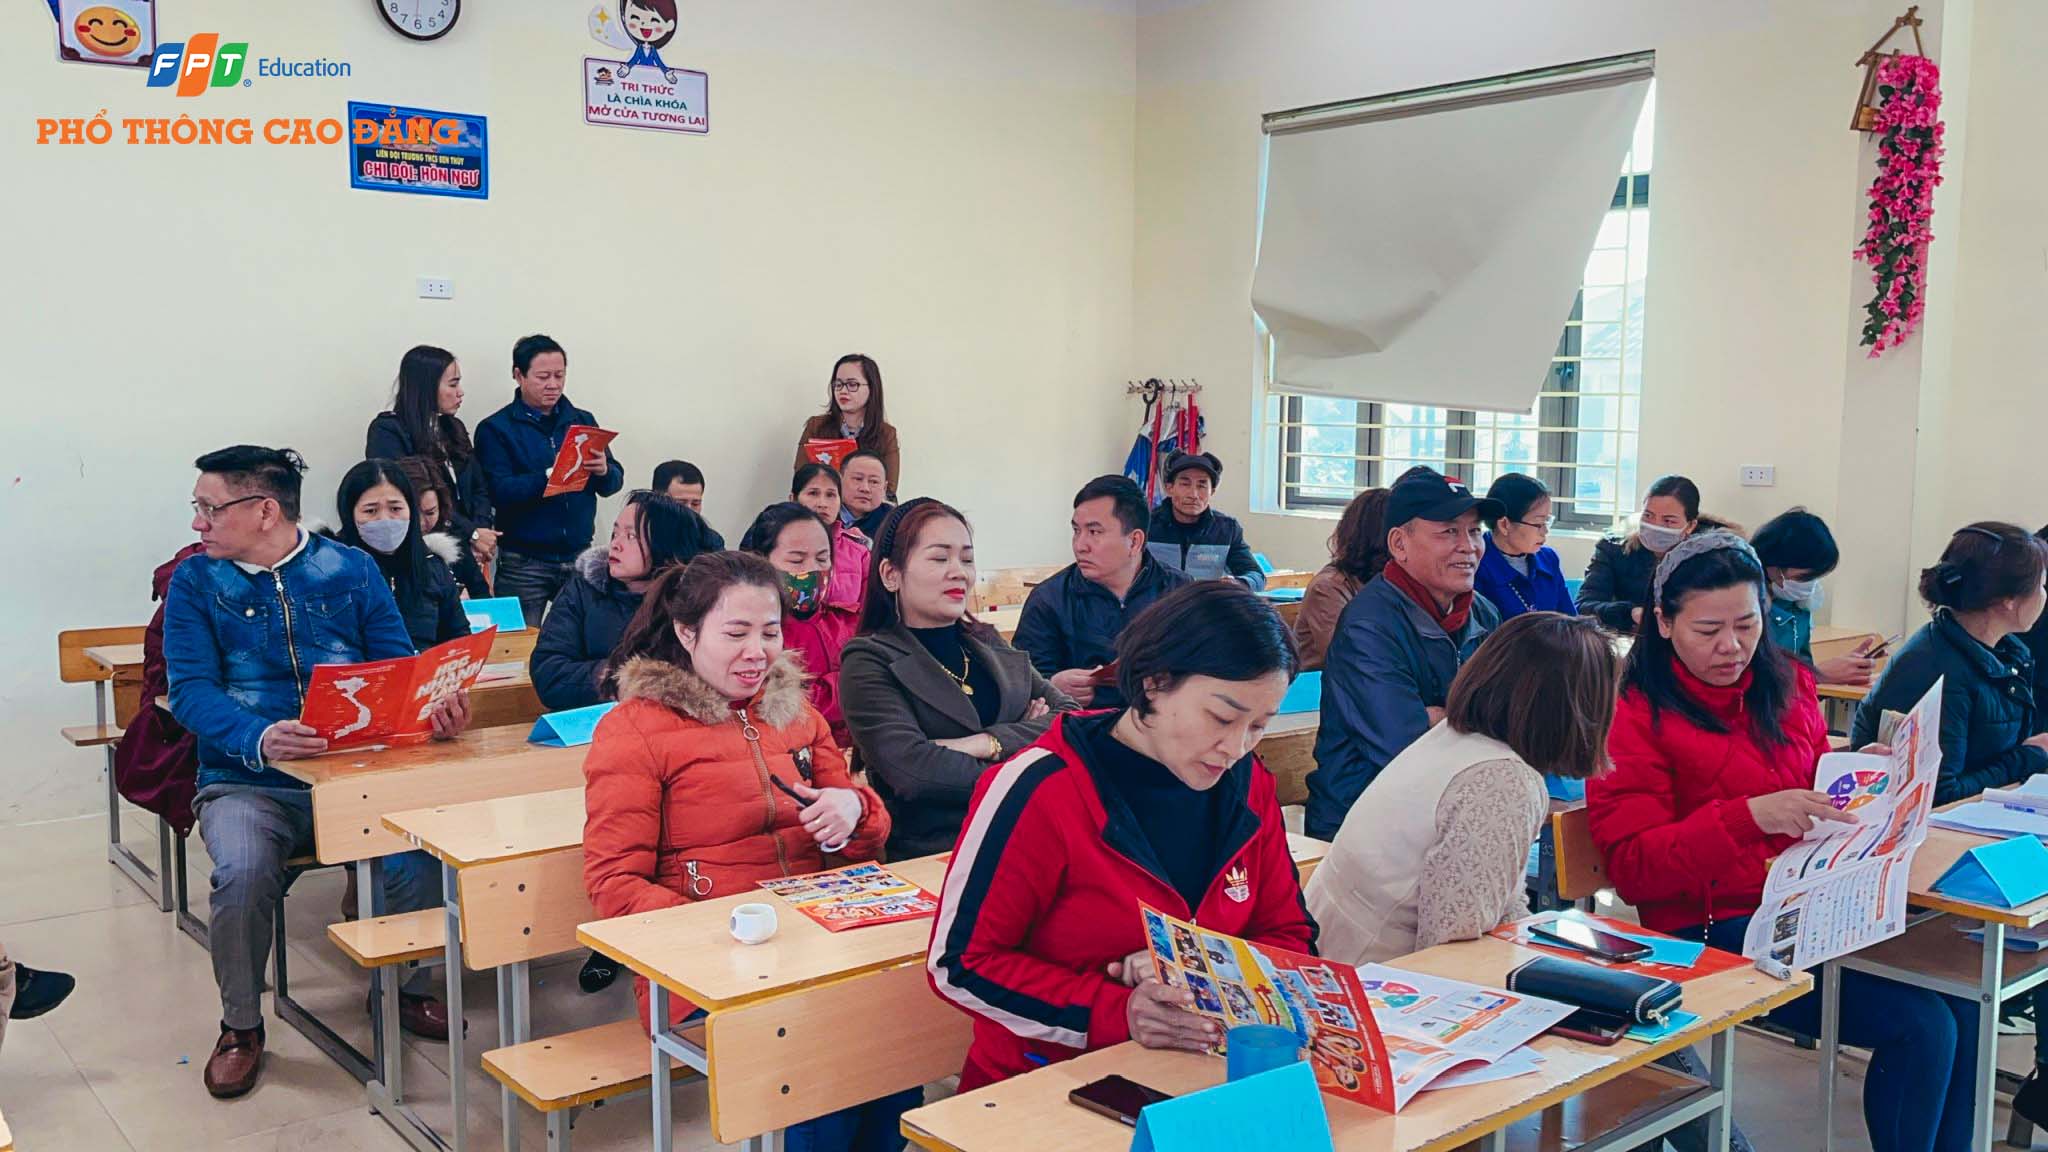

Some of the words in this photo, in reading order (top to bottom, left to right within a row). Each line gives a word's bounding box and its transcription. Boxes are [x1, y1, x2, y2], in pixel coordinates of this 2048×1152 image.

[390, 2, 398, 13] 8
[400, 13, 408, 24] 7
[437, 9, 445, 19] 4
[414, 19, 422, 29] 6
[428, 17, 436, 28] 5
[620, 82, 639, 92] TRI
[641, 84, 675, 96] THỨC
[607, 93, 622, 103] LÀ
[624, 94, 653, 107] CHÌA
[655, 98, 688, 110] KHÓA
[588, 104, 612, 117] MỞ
[614, 106, 639, 119] CỬA
[642, 111, 685, 124] TƯƠNG
[688, 116, 705, 126] LAI
[363, 160, 388, 178] CHI
